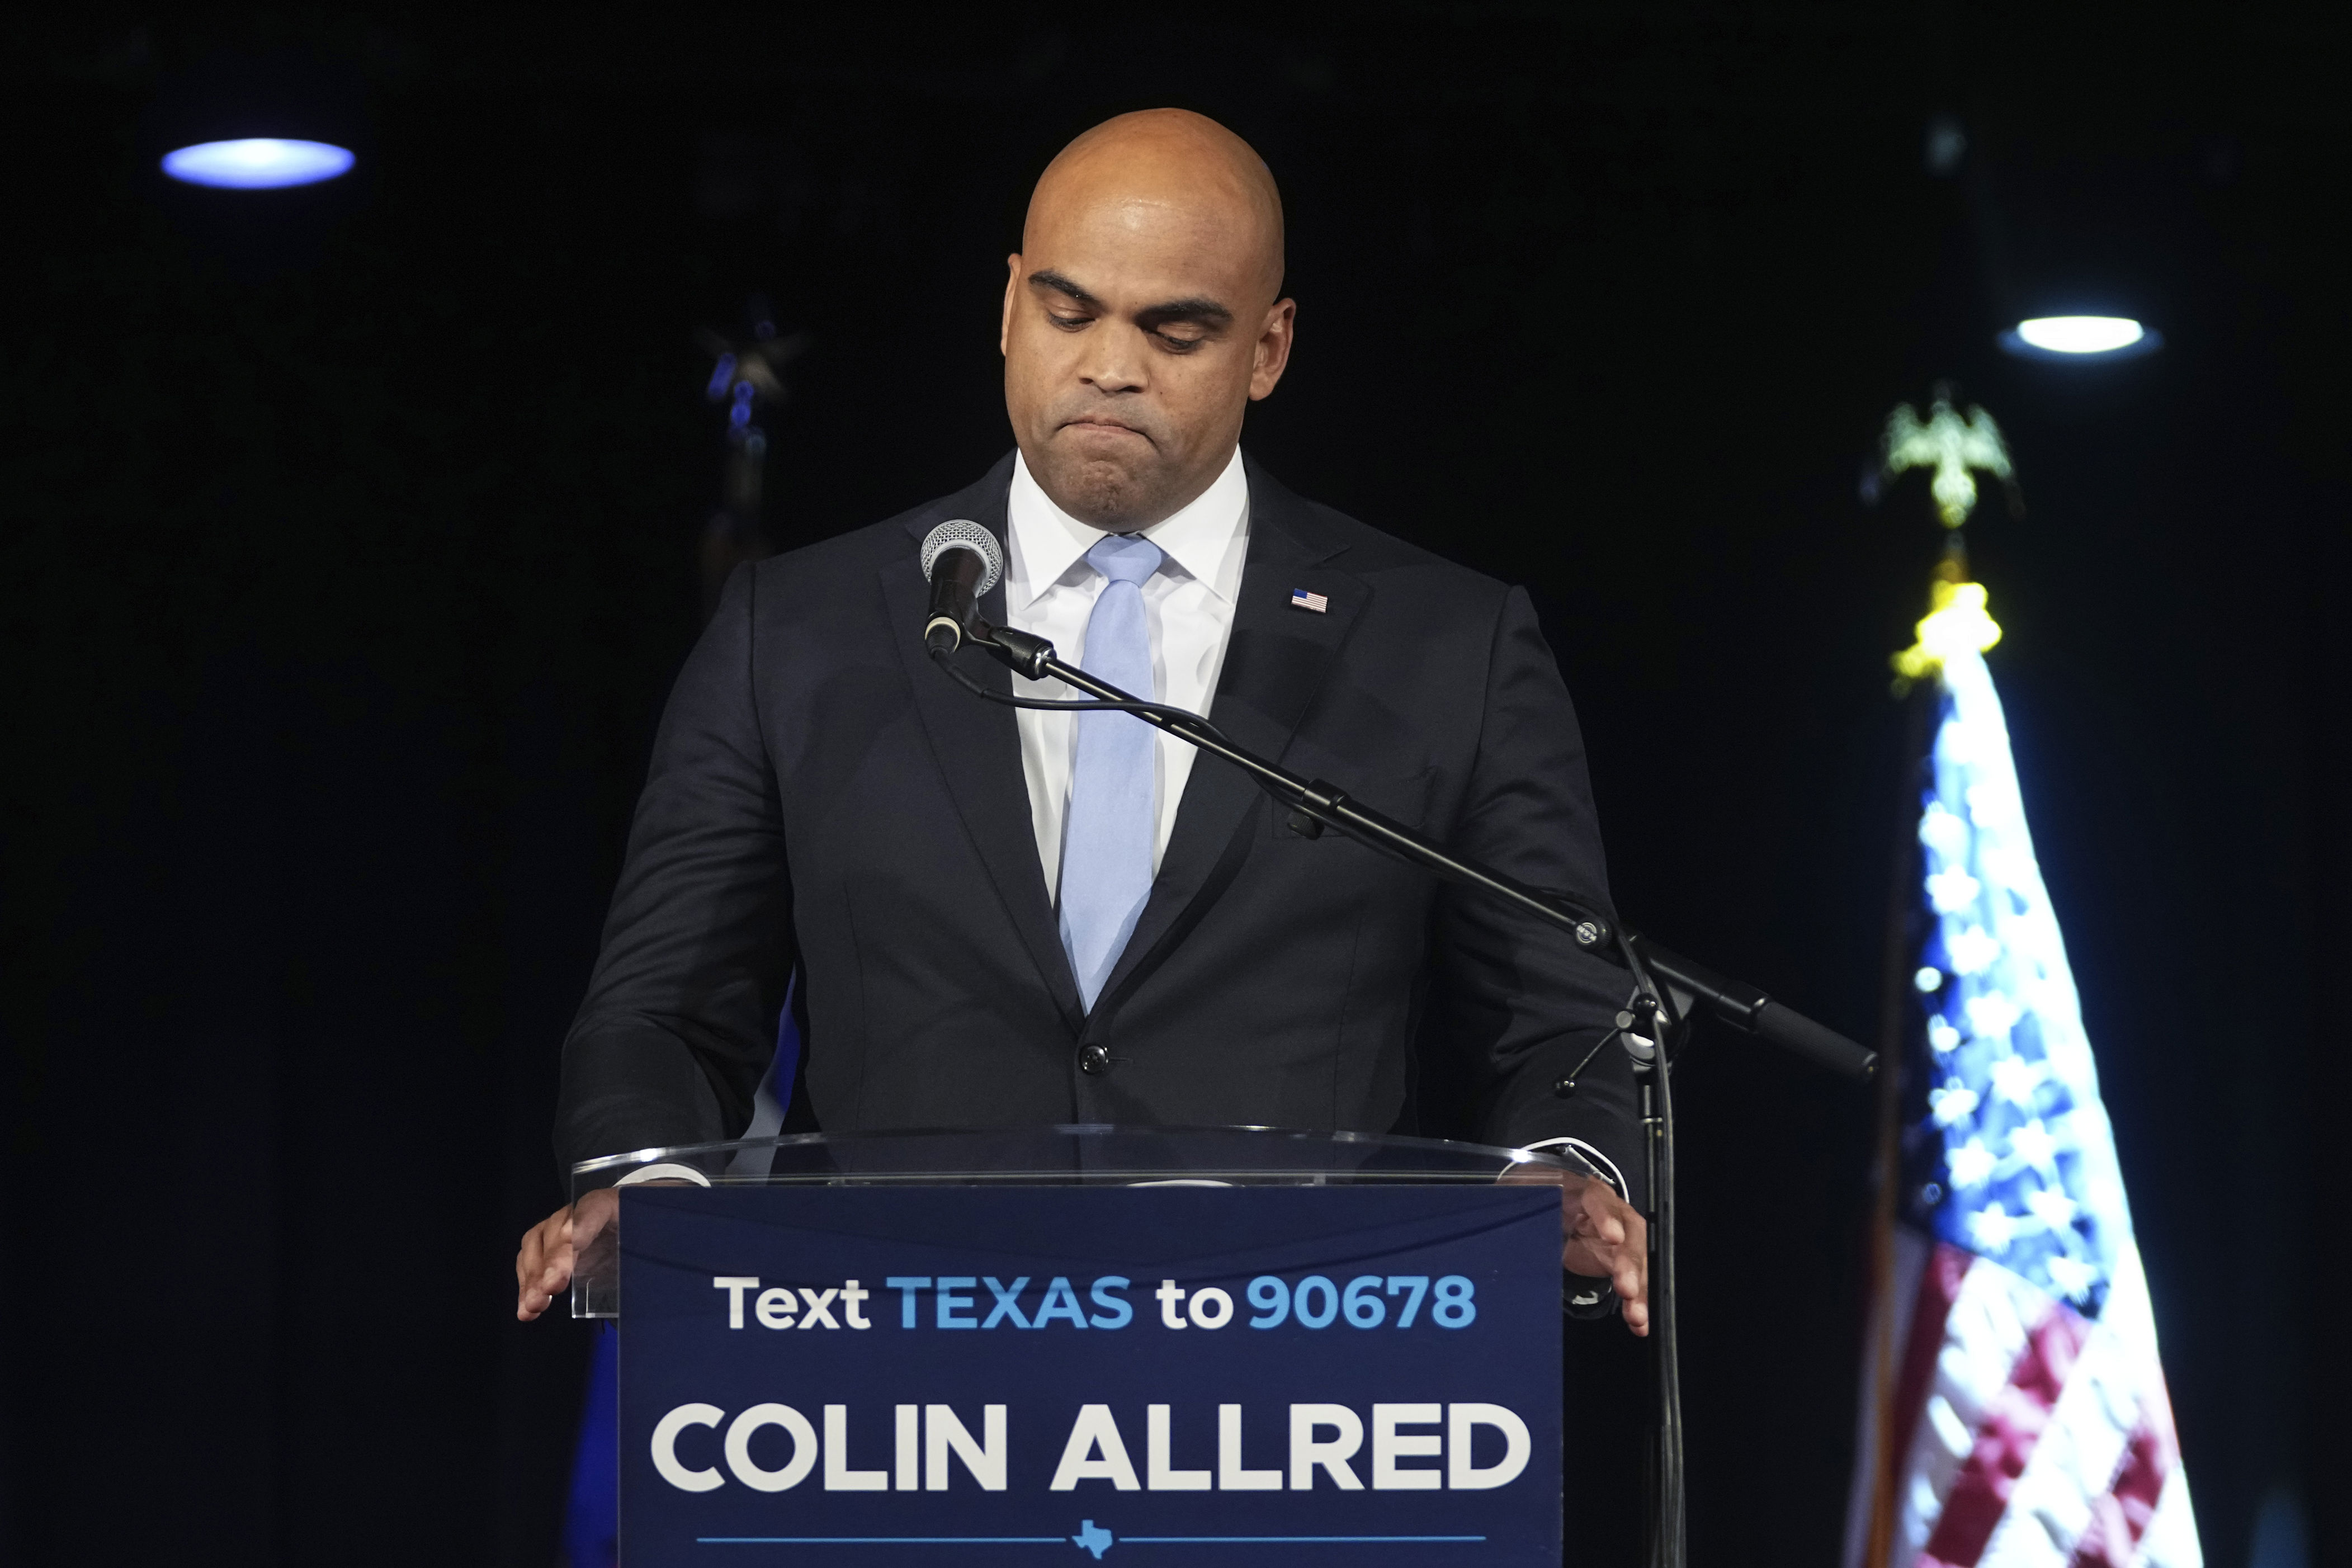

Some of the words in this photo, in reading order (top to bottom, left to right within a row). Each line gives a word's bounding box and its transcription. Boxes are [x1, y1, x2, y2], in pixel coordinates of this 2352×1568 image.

[713, 1276, 872, 1331] Text
[885, 1275, 1134, 1331] TEXAS
[1155, 1279, 1234, 1331] to
[1245, 1274, 1477, 1331] 90678
[650, 1402, 1008, 1493] COLIN
[1049, 1402, 1532, 1492] ALLRED
